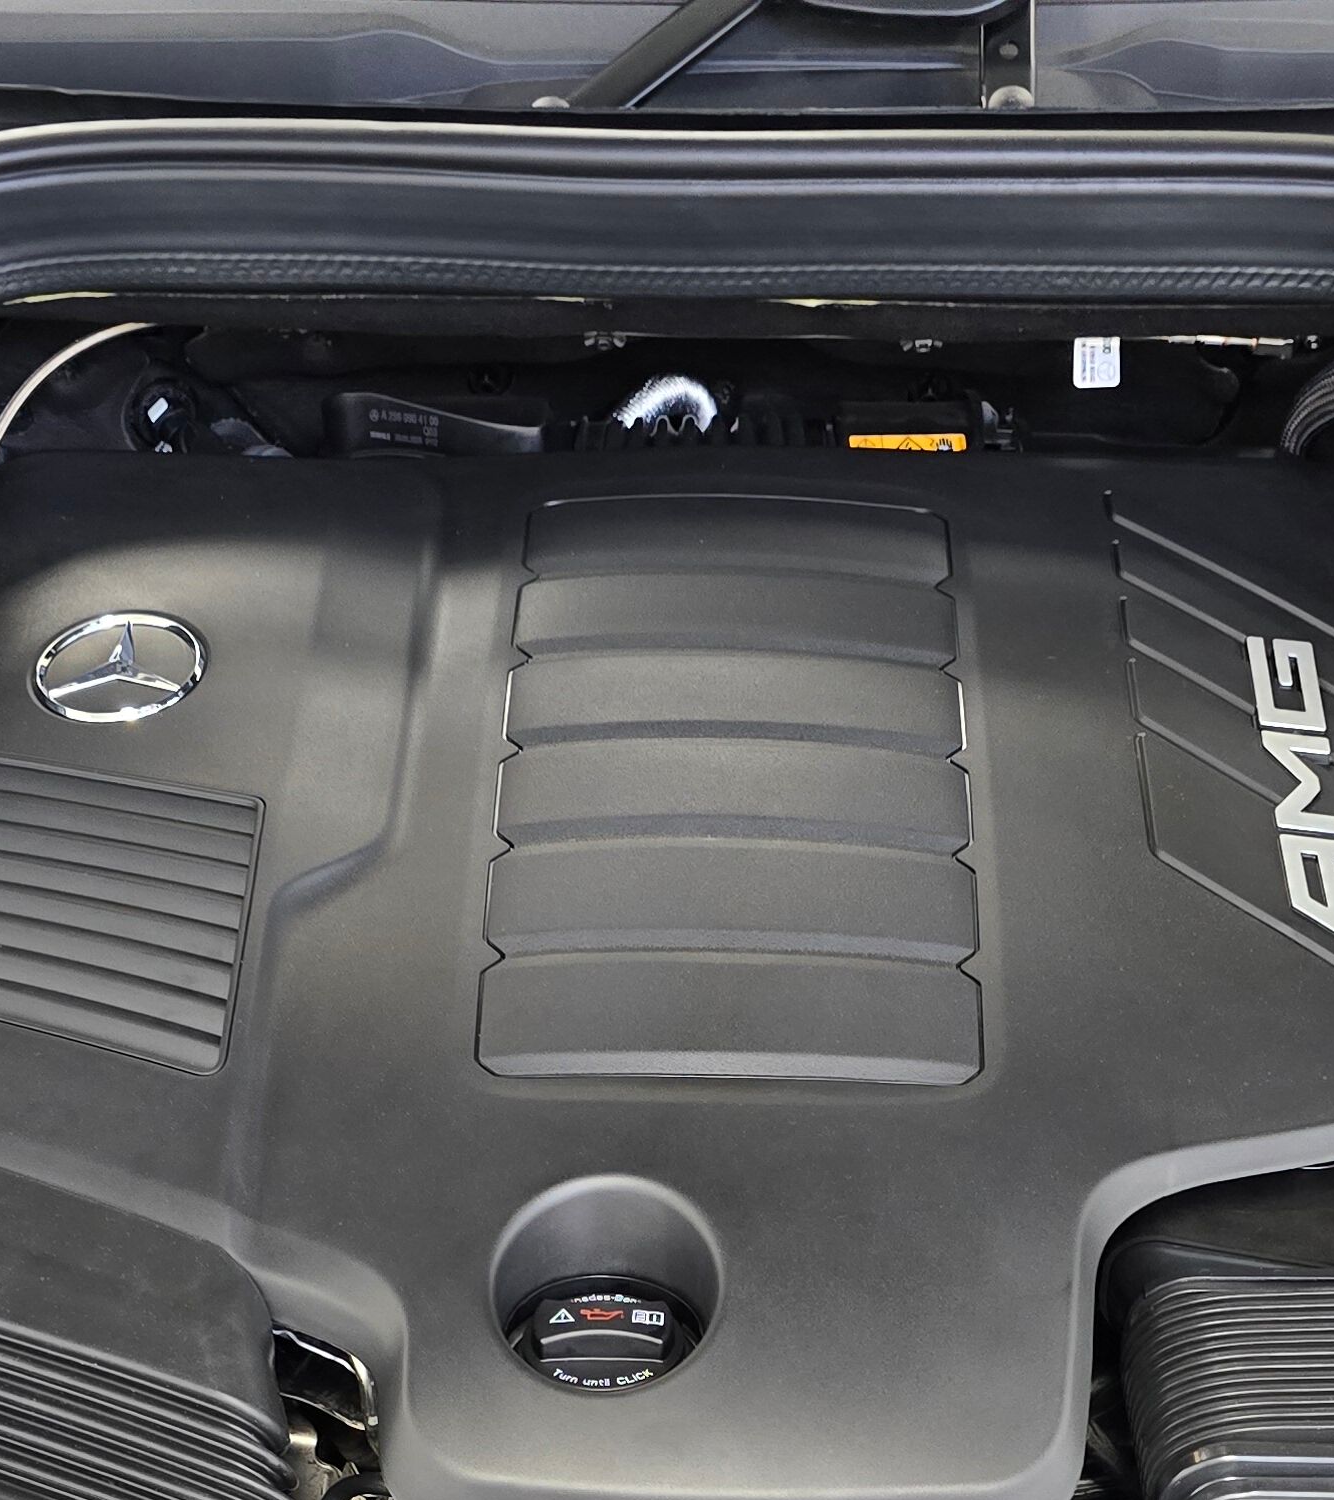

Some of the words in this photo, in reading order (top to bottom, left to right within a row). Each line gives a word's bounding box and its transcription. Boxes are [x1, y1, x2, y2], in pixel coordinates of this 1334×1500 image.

[552, 1368, 579, 1385] Turn
[582, 1378, 611, 1388] until
[616, 1368, 655, 1386] CLICK
